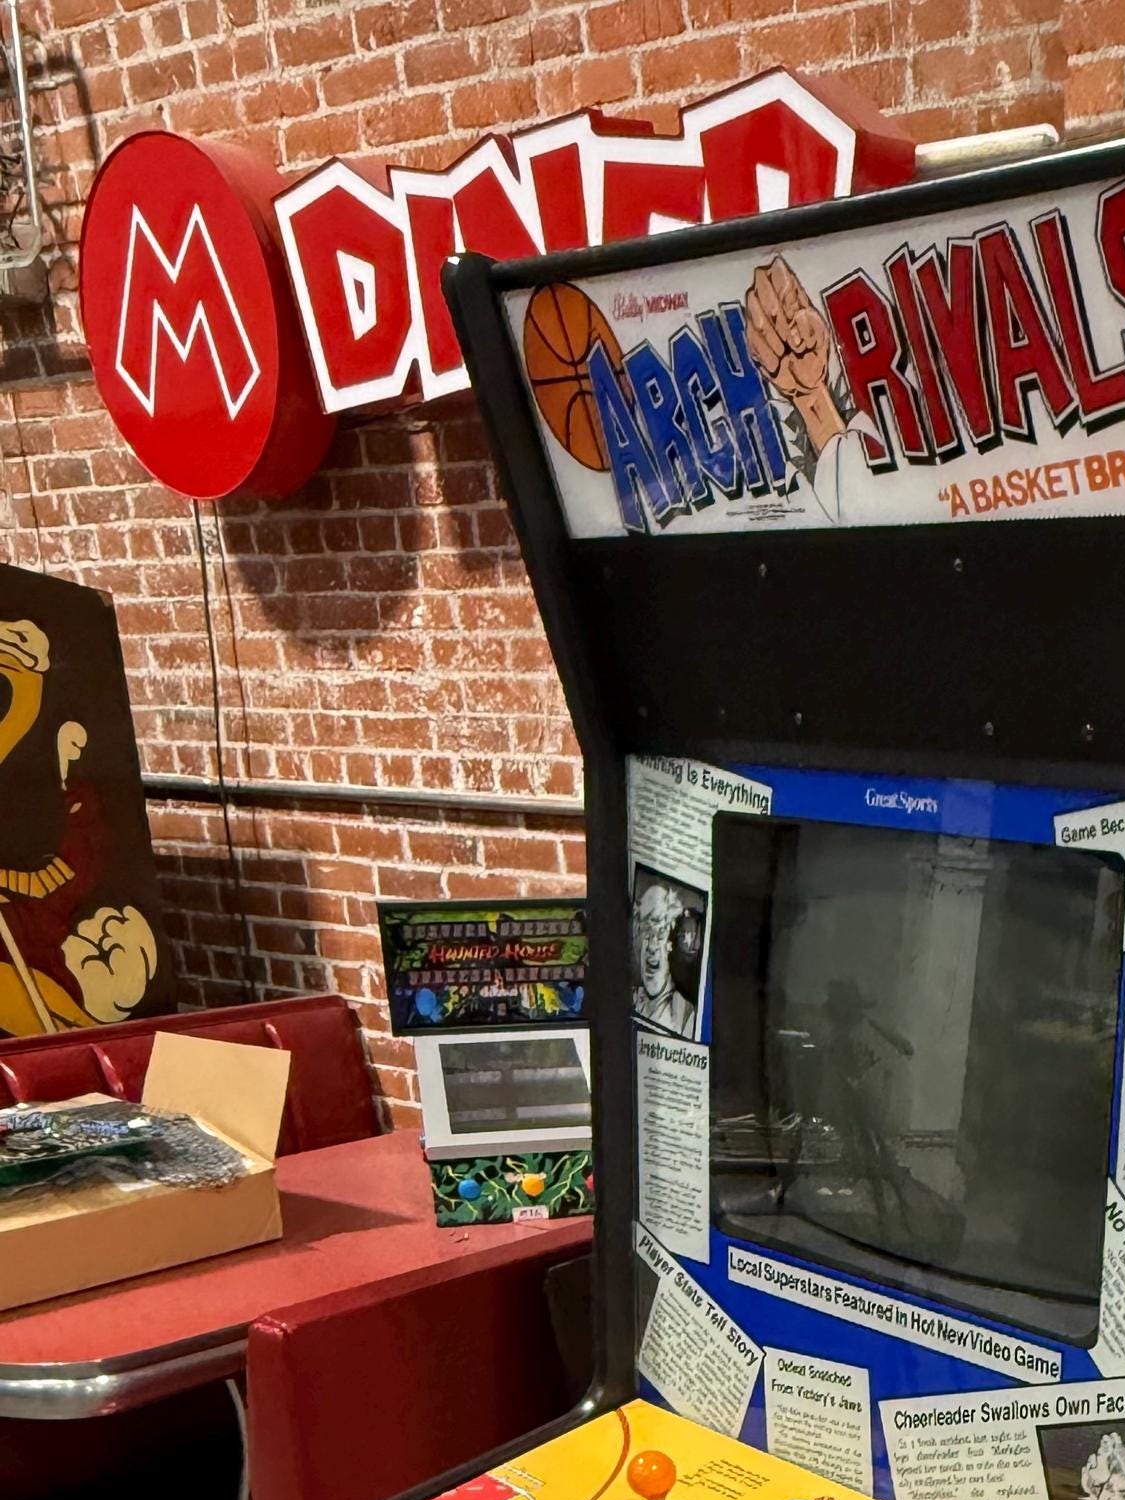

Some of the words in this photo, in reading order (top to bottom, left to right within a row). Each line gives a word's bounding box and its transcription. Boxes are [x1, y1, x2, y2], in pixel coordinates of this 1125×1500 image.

[587, 299, 797, 533] ARCH
[700, 770, 770, 815] Everything
[1061, 824, 1097, 843] Game
[638, 1039, 708, 1070] Instructions
[1105, 1201, 1125, 1232] No
[638, 1234, 674, 1276] Player
[673, 1271, 704, 1307] Stats
[701, 1301, 727, 1332] Tell
[726, 1329, 759, 1367] Story
[730, 1252, 763, 1279] Local
[763, 1263, 833, 1302] Superstars
[833, 1285, 894, 1322] Featured
[910, 1310, 936, 1334] Hot
[936, 1319, 969, 1347] New
[969, 1329, 1011, 1362] Video
[1014, 1345, 1060, 1379] Game
[893, 1405, 976, 1430] Cheerleader
[980, 1399, 1051, 1424] Swallows
[1055, 1395, 1091, 1418] Own
